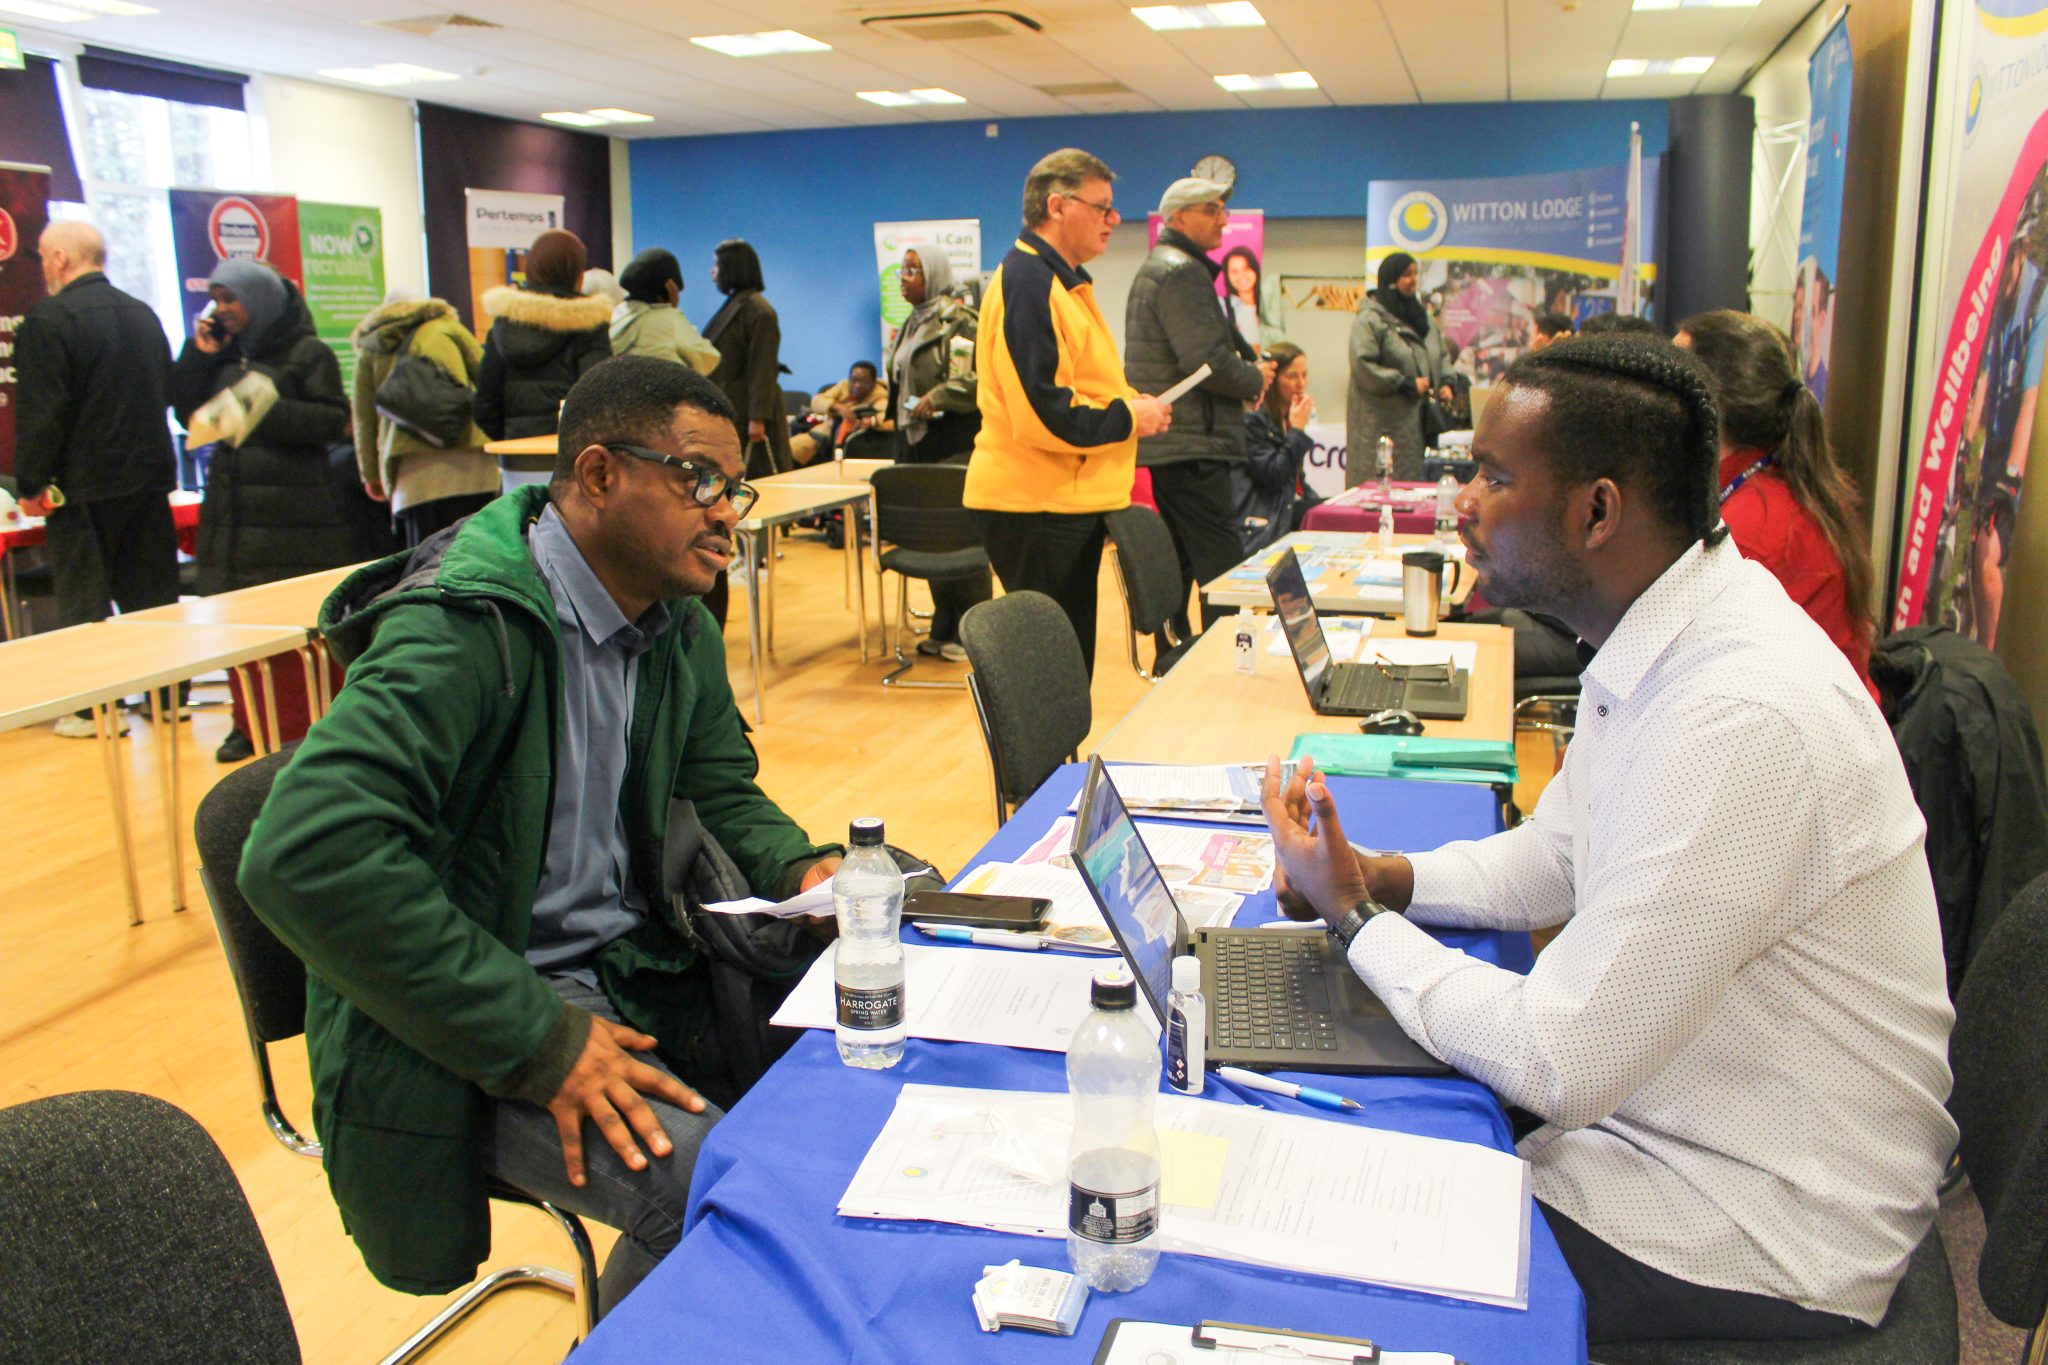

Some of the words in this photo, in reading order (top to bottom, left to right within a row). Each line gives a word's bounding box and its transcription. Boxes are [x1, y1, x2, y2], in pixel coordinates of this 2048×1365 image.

[476, 207, 544, 223] Pertemps
[1452, 201, 1527, 223] WITTON
[1532, 196, 1584, 220] LODGE
[309, 233, 354, 254] NOW
[936, 233, 973, 245] I-Can
[1907, 482, 1934, 577] and
[1925, 233, 2003, 471] Wellbeing
[840, 996, 898, 1010] HARROGATE
[850, 1008, 869, 1016] SPRING
[869, 1008, 887, 1016] WATER
